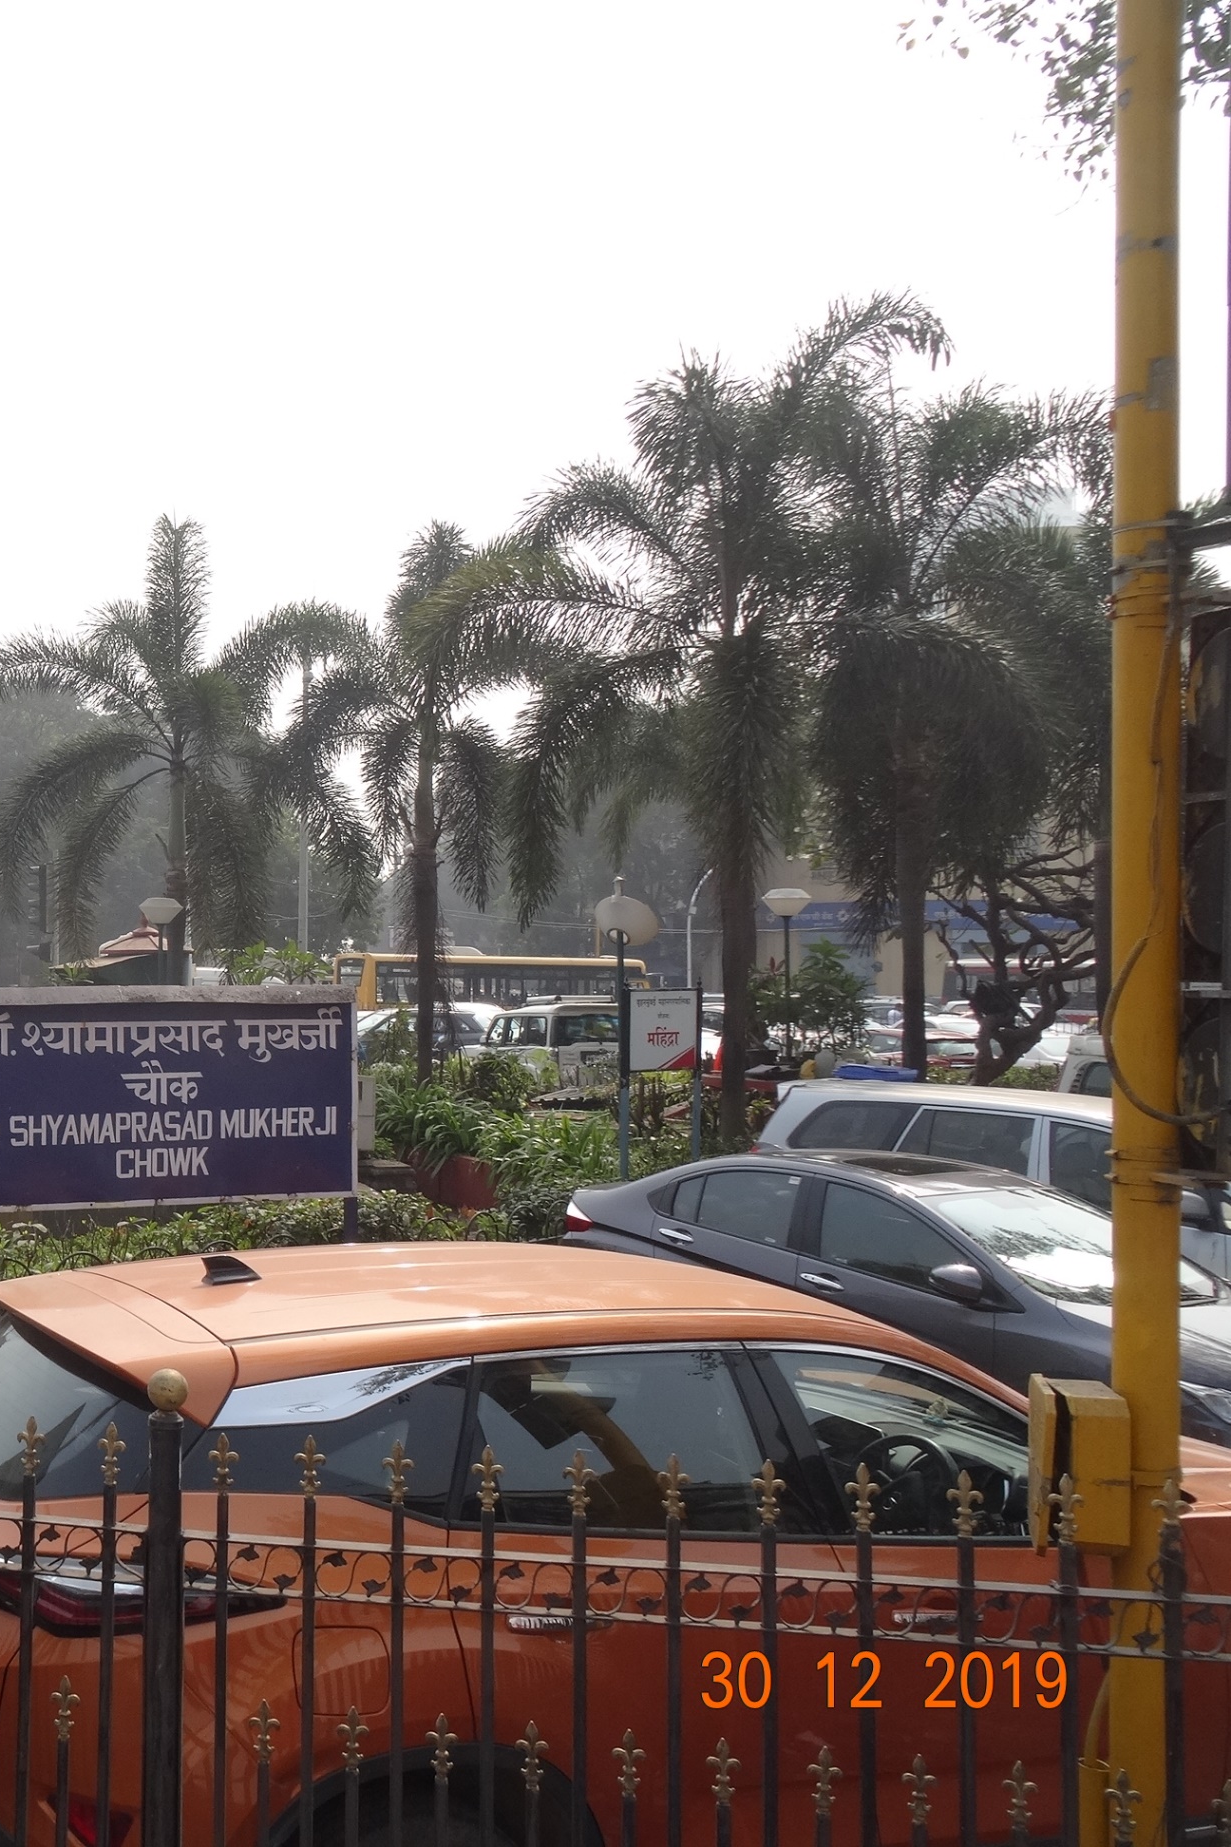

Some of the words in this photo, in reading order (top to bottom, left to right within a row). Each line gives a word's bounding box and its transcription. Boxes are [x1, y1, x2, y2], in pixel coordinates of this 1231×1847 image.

[21, 1019, 228, 1058] श्यामाप्रसाद
[233, 1005, 344, 1063] मुखर्जी
[647, 1026, 680, 1048] महिंद्रा
[120, 1060, 204, 1105] चौक
[10, 1109, 213, 1147] SHYAMAPRASAD
[220, 1106, 337, 1139] MUKHERJI
[115, 1147, 209, 1179] CHOWK
